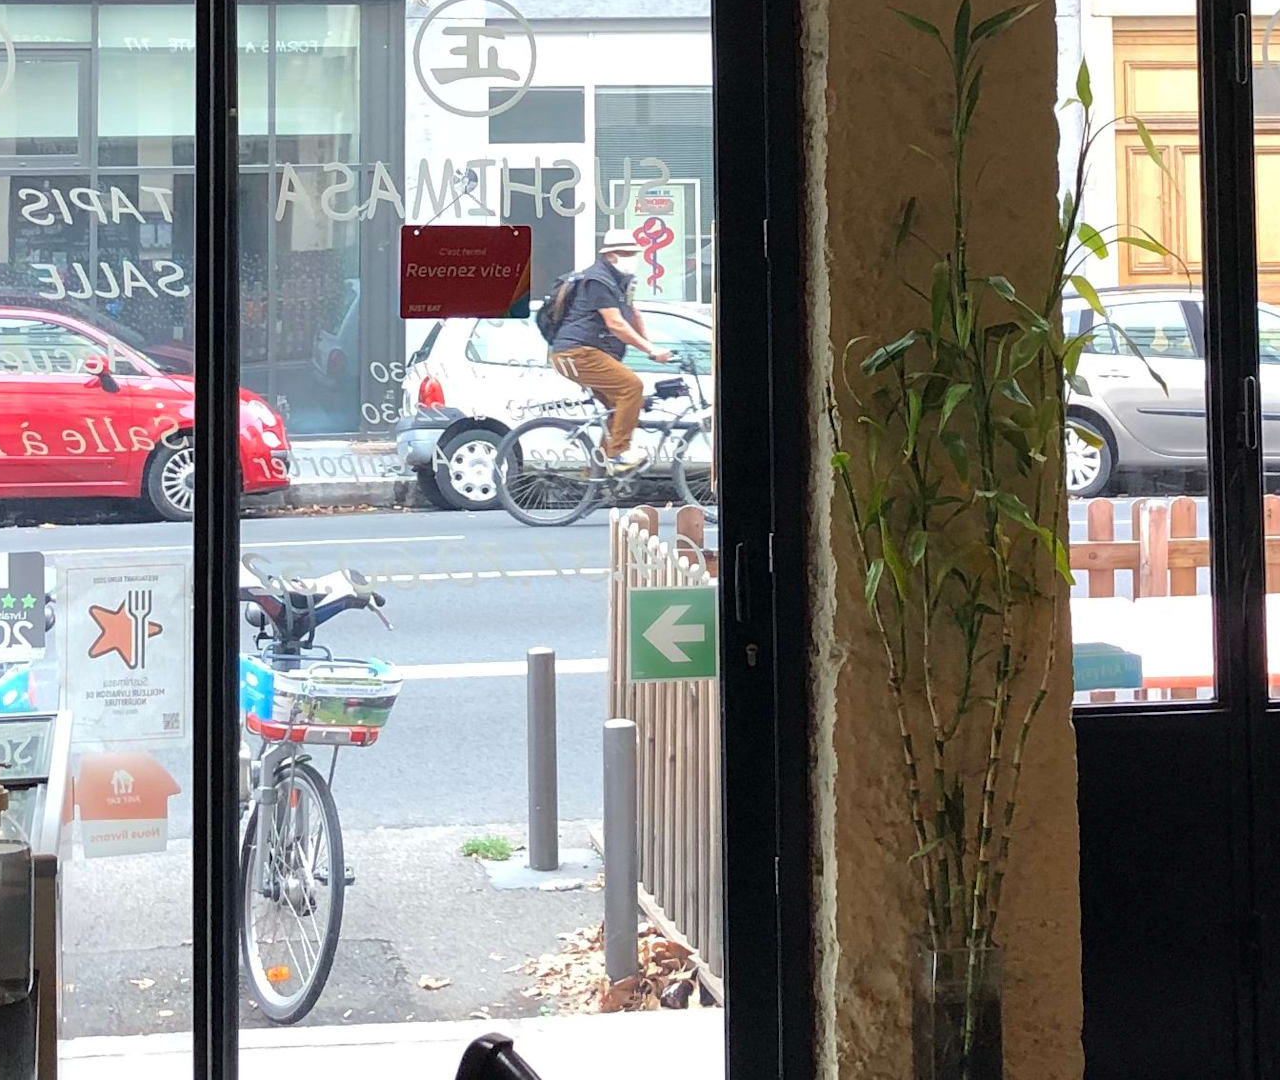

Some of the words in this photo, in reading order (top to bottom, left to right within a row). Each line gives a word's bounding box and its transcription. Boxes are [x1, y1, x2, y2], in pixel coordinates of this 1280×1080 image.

[406, 263, 476, 278] Revenez
[480, 263, 512, 278] vite
[515, 263, 521, 277] !
